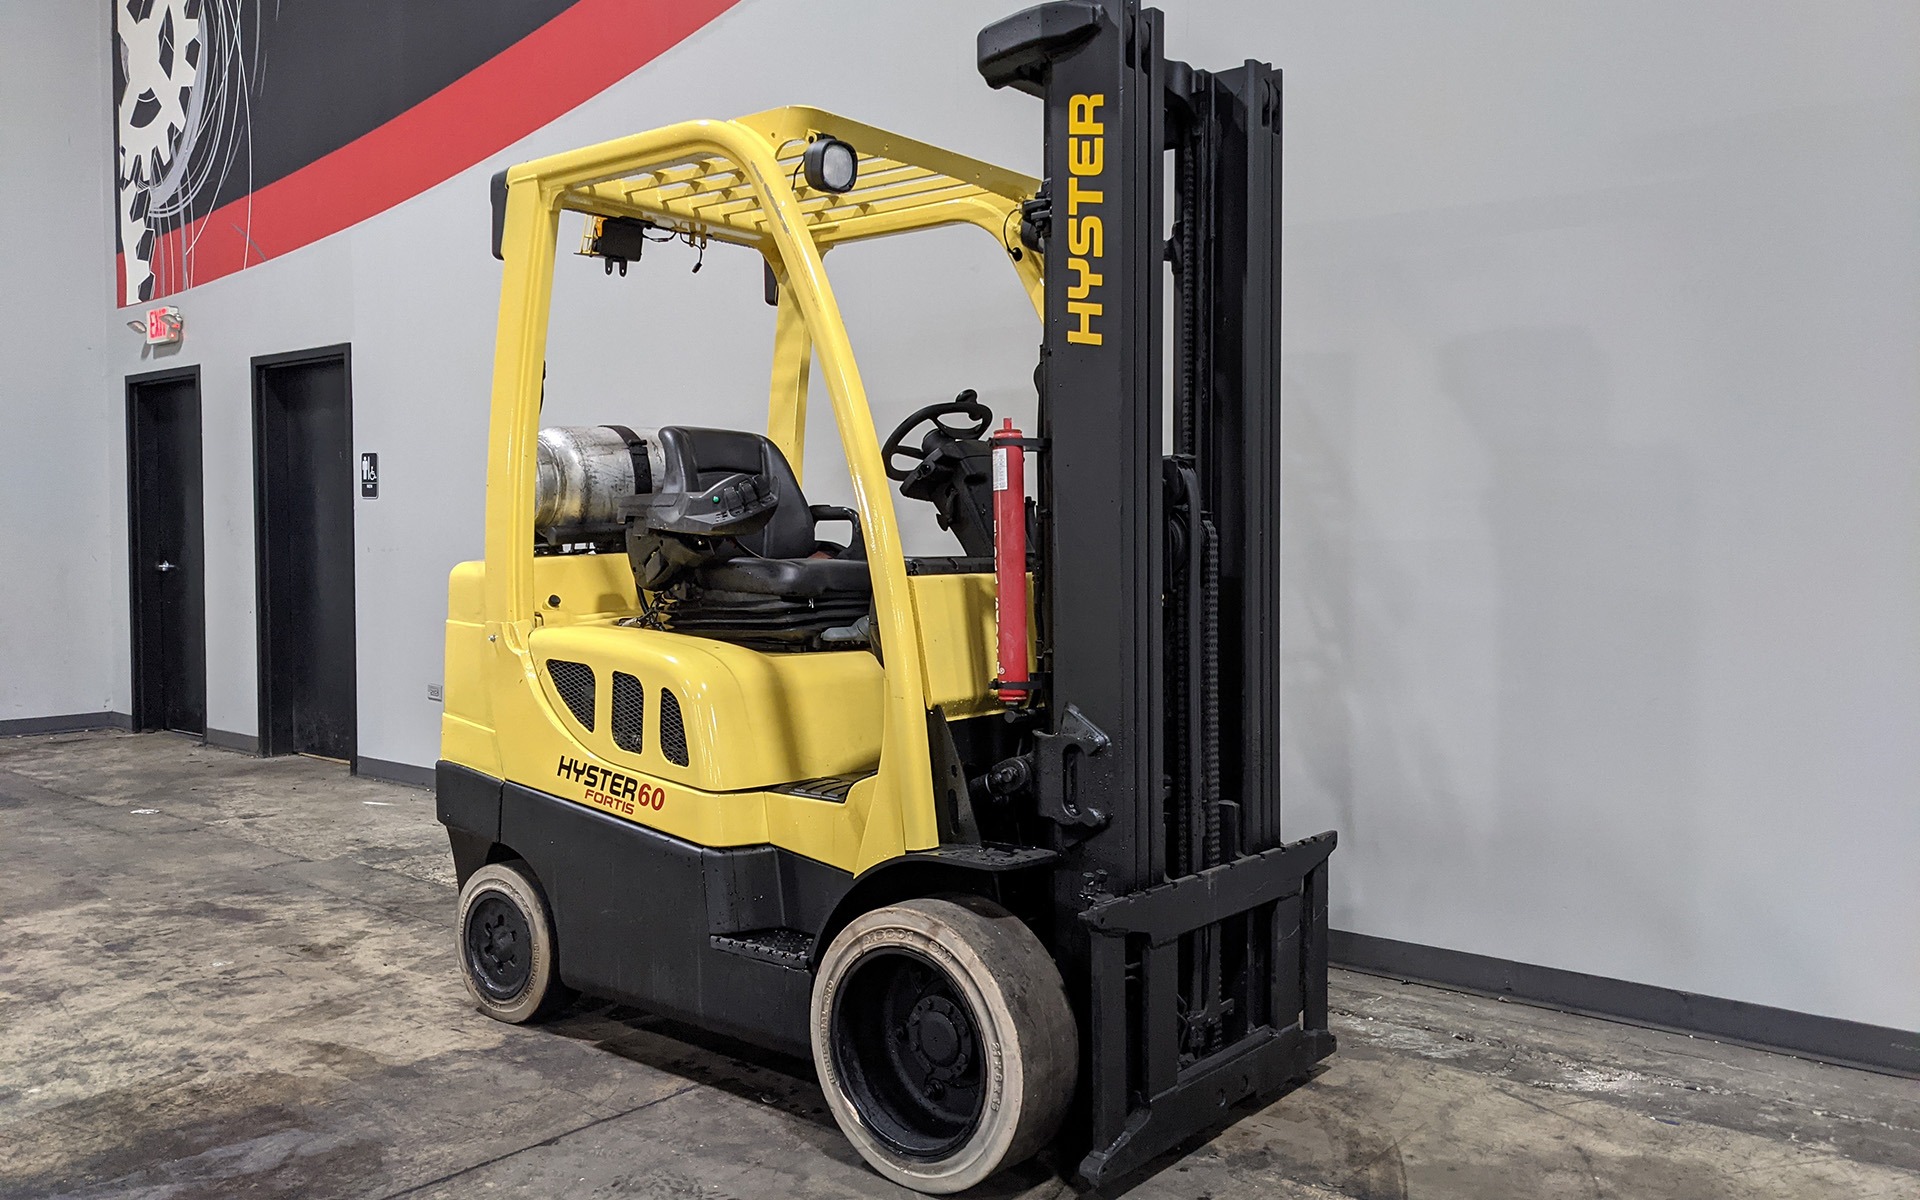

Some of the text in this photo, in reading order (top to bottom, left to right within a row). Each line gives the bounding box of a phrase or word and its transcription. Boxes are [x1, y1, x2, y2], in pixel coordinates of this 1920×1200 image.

[1068, 94, 1104, 346] HYSTER
[557, 755, 665, 811] HYSTER 60
[585, 789, 634, 815] FORTIS
